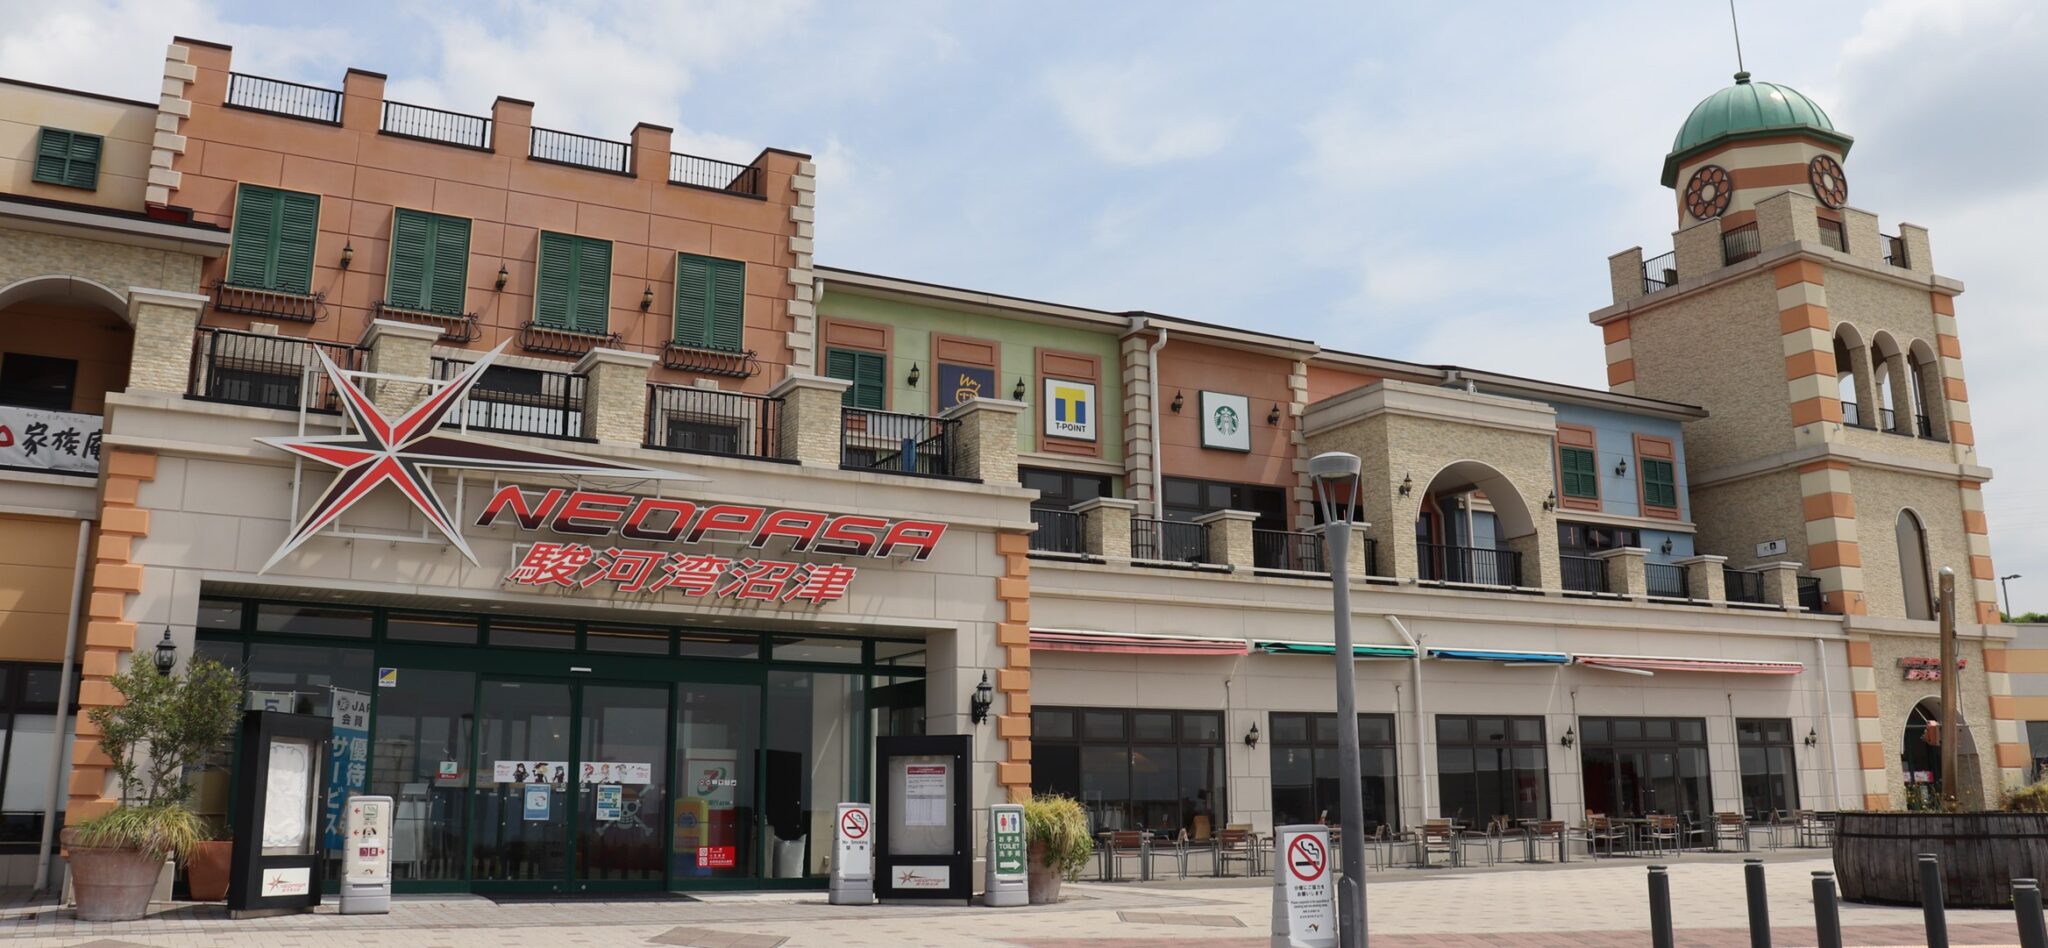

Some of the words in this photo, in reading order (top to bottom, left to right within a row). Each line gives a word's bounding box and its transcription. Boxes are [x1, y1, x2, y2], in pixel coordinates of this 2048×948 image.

[1056, 422, 1087, 433] T-POINT
[474, 485, 948, 561] NEOPASA
[509, 542, 857, 604] 駿河湾沼津
[342, 713, 364, 728] 会員
[324, 735, 348, 835] サービス
